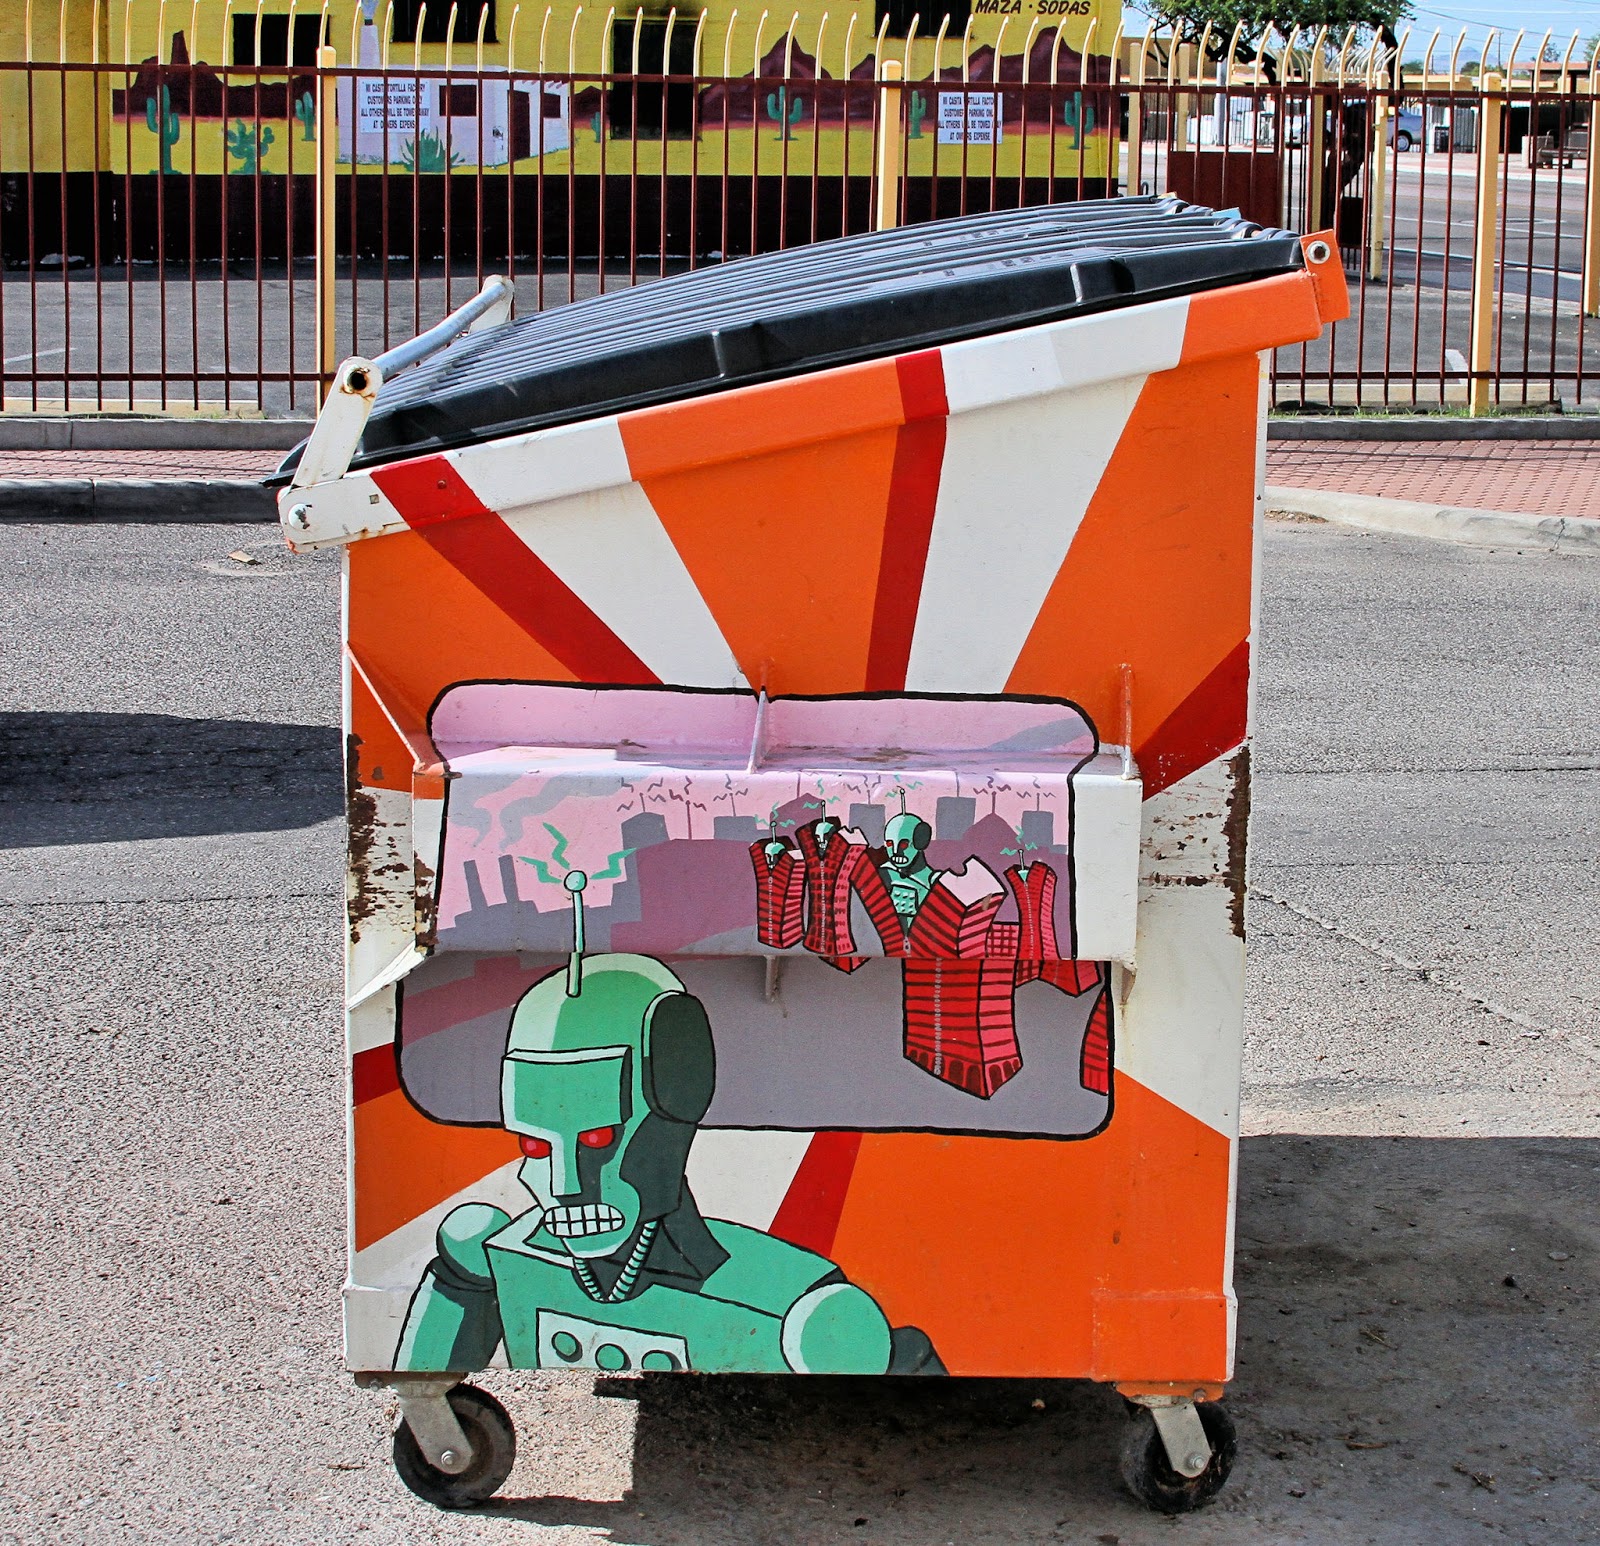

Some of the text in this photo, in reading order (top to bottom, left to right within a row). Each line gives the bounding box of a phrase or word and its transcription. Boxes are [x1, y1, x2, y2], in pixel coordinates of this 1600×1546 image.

[975, 0, 1091, 15] MAZA SODAS
[393, 96, 411, 104] PARKING
[397, 108, 402, 116] BE
[403, 108, 415, 116] TOWE
[969, 109, 985, 117] PARKING
[373, 120, 378, 128] AT
[400, 120, 415, 128] EXPENS
[950, 132, 955, 140] AT
[974, 132, 991, 140] EXPENSE
